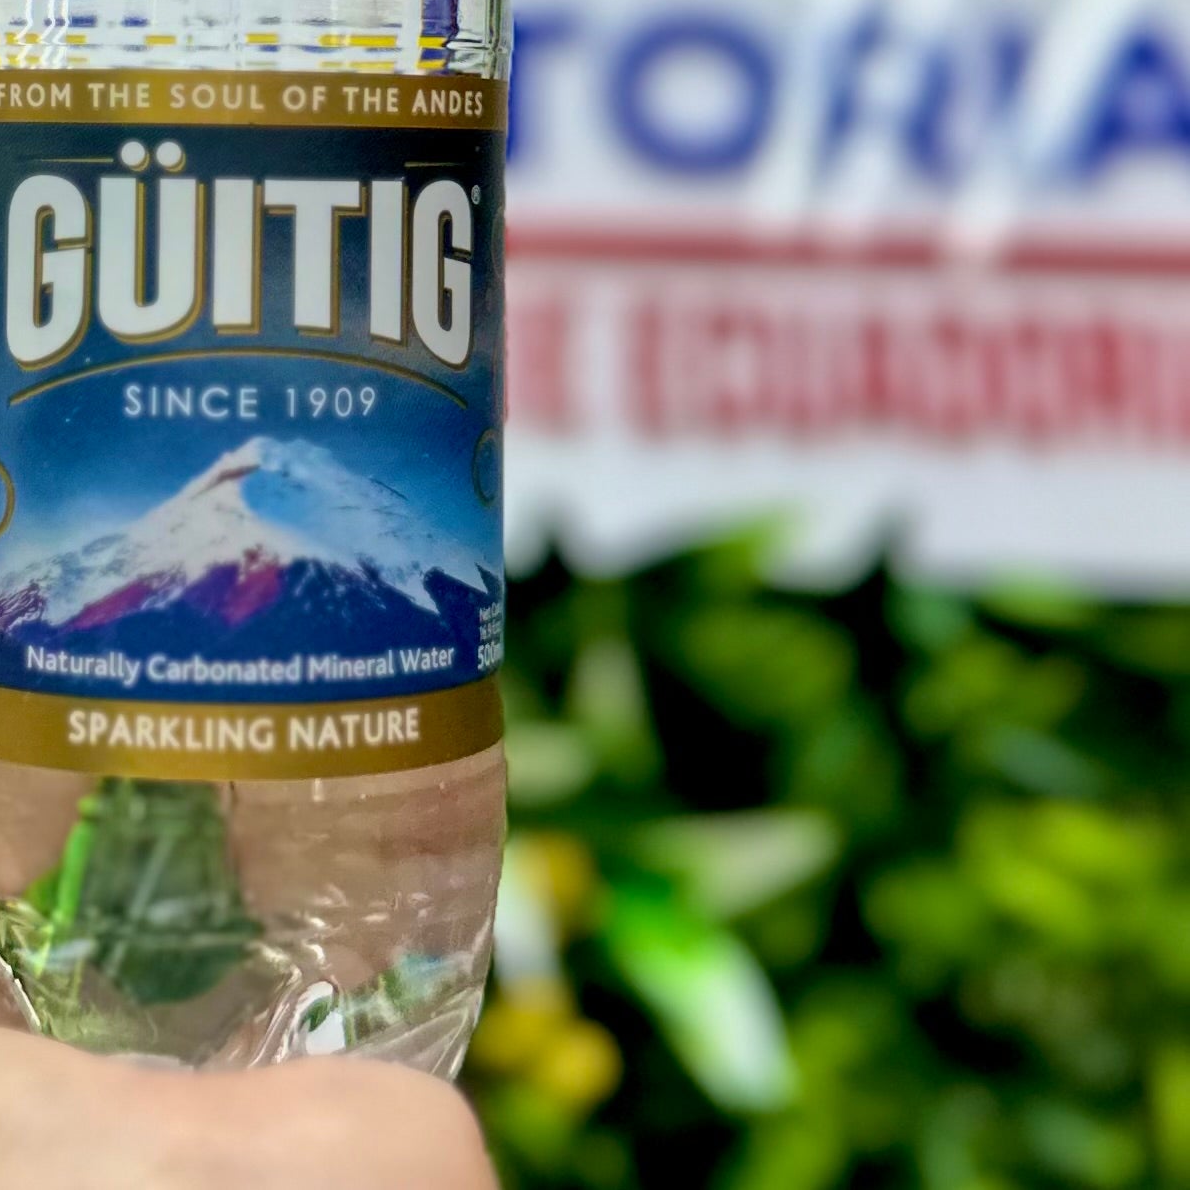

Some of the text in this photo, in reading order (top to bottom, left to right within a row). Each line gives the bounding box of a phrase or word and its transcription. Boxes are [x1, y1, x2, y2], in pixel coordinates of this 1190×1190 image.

[88, 82, 150, 108] THE
[170, 83, 264, 110] SOUL
[281, 85, 327, 111] OF
[341, 86, 398, 113] THE
[412, 89, 484, 117] ANDES
[6, 140, 474, 372] GÜITIG
[125, 385, 376, 418] SINCE 1909
[26, 645, 455, 687] Naturally Carbonated Mineral Water
[68, 707, 421, 751] SPARKLING NATURE
